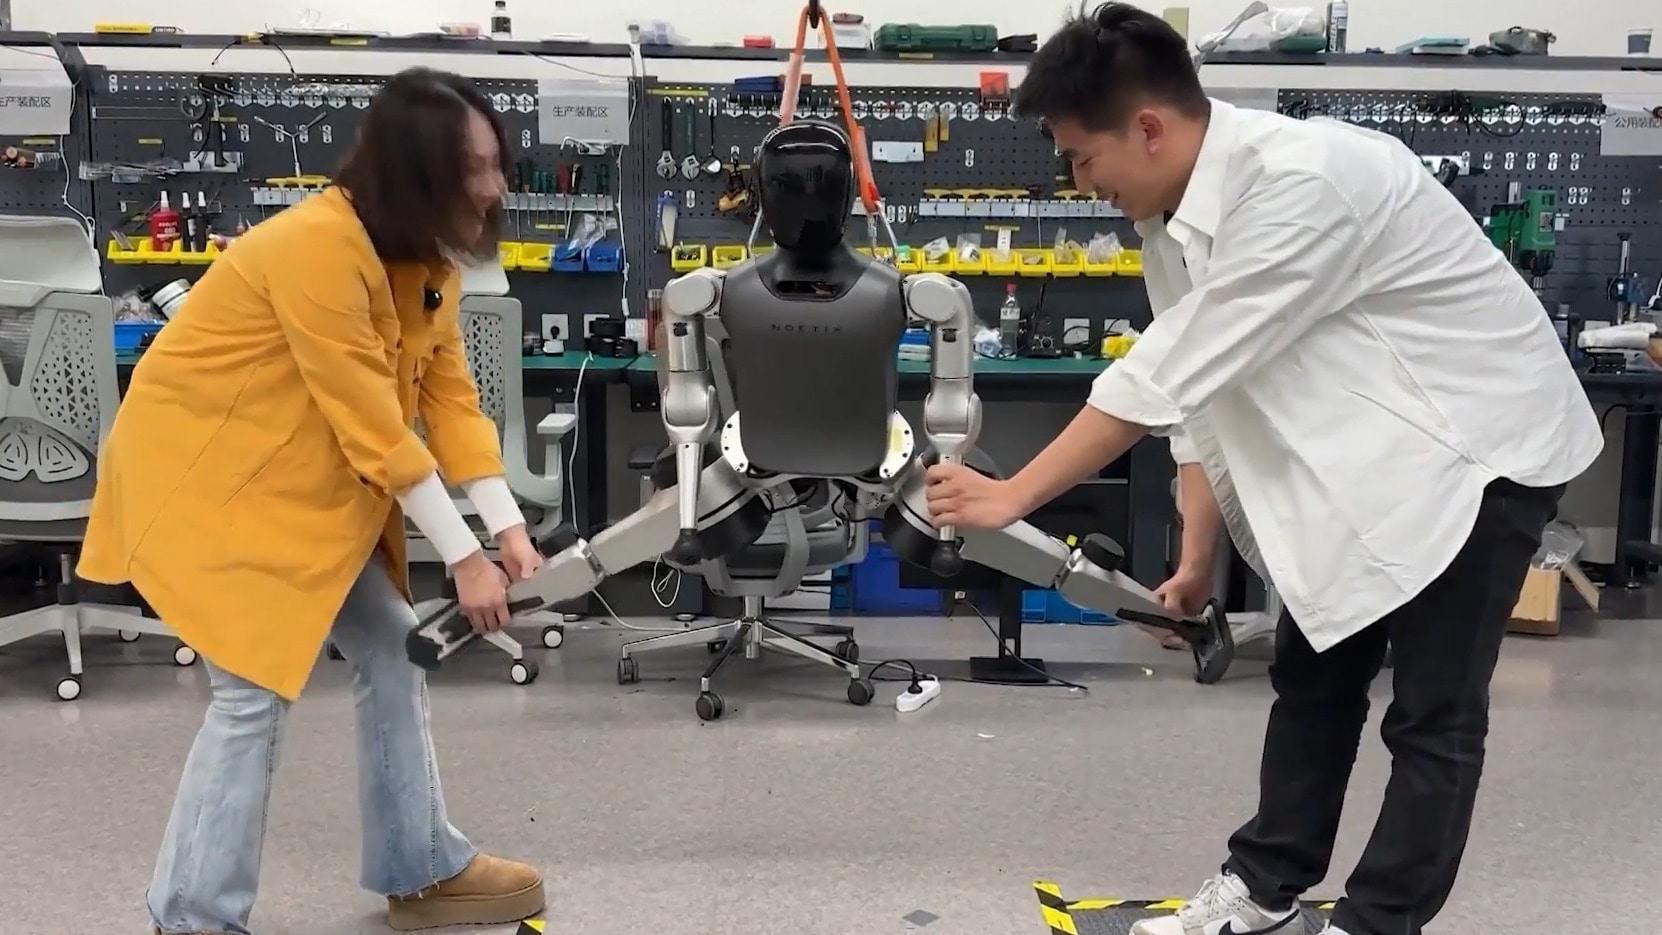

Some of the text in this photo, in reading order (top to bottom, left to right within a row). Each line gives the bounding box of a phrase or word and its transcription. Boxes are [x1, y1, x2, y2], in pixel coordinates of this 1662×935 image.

[552, 105, 608, 118] 生产装配区
[1615, 116, 1662, 128] 公用装配
